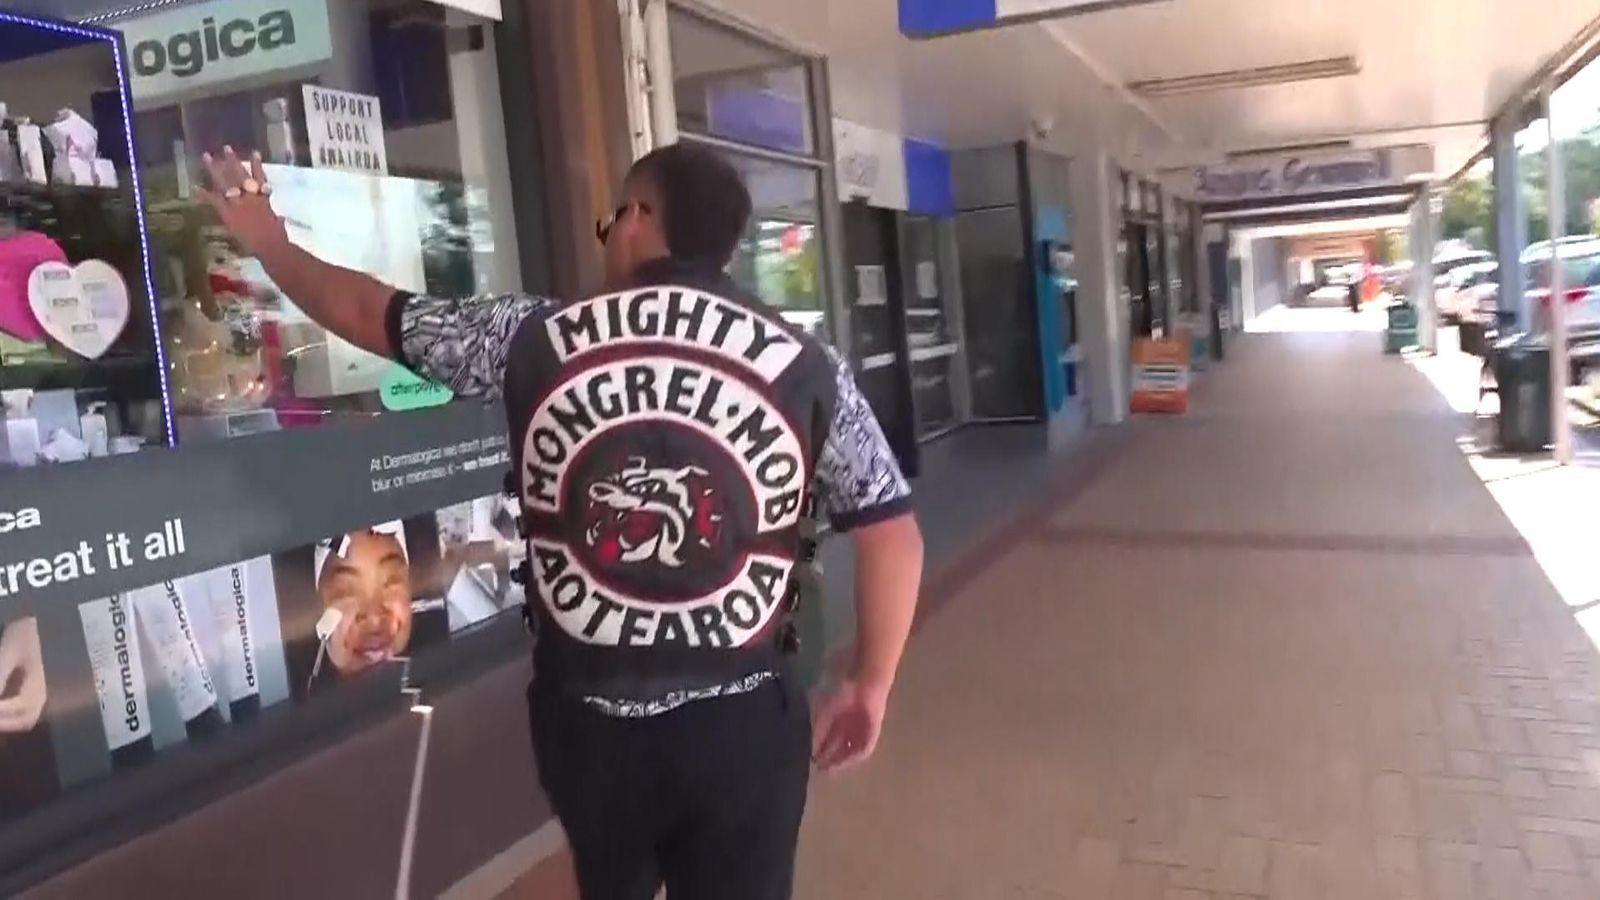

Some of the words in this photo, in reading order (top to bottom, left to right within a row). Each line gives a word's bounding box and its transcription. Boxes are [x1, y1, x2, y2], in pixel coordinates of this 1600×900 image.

[133, 9, 296, 77] ogica
[313, 91, 372, 118] SUPPORT
[326, 122, 369, 144] LOCAL
[554, 290, 791, 361] MIGHTY
[106, 532, 133, 570] it
[144, 518, 185, 560] all
[231, 567, 255, 687] dermalogica
[533, 544, 786, 649] AOTEAROA
